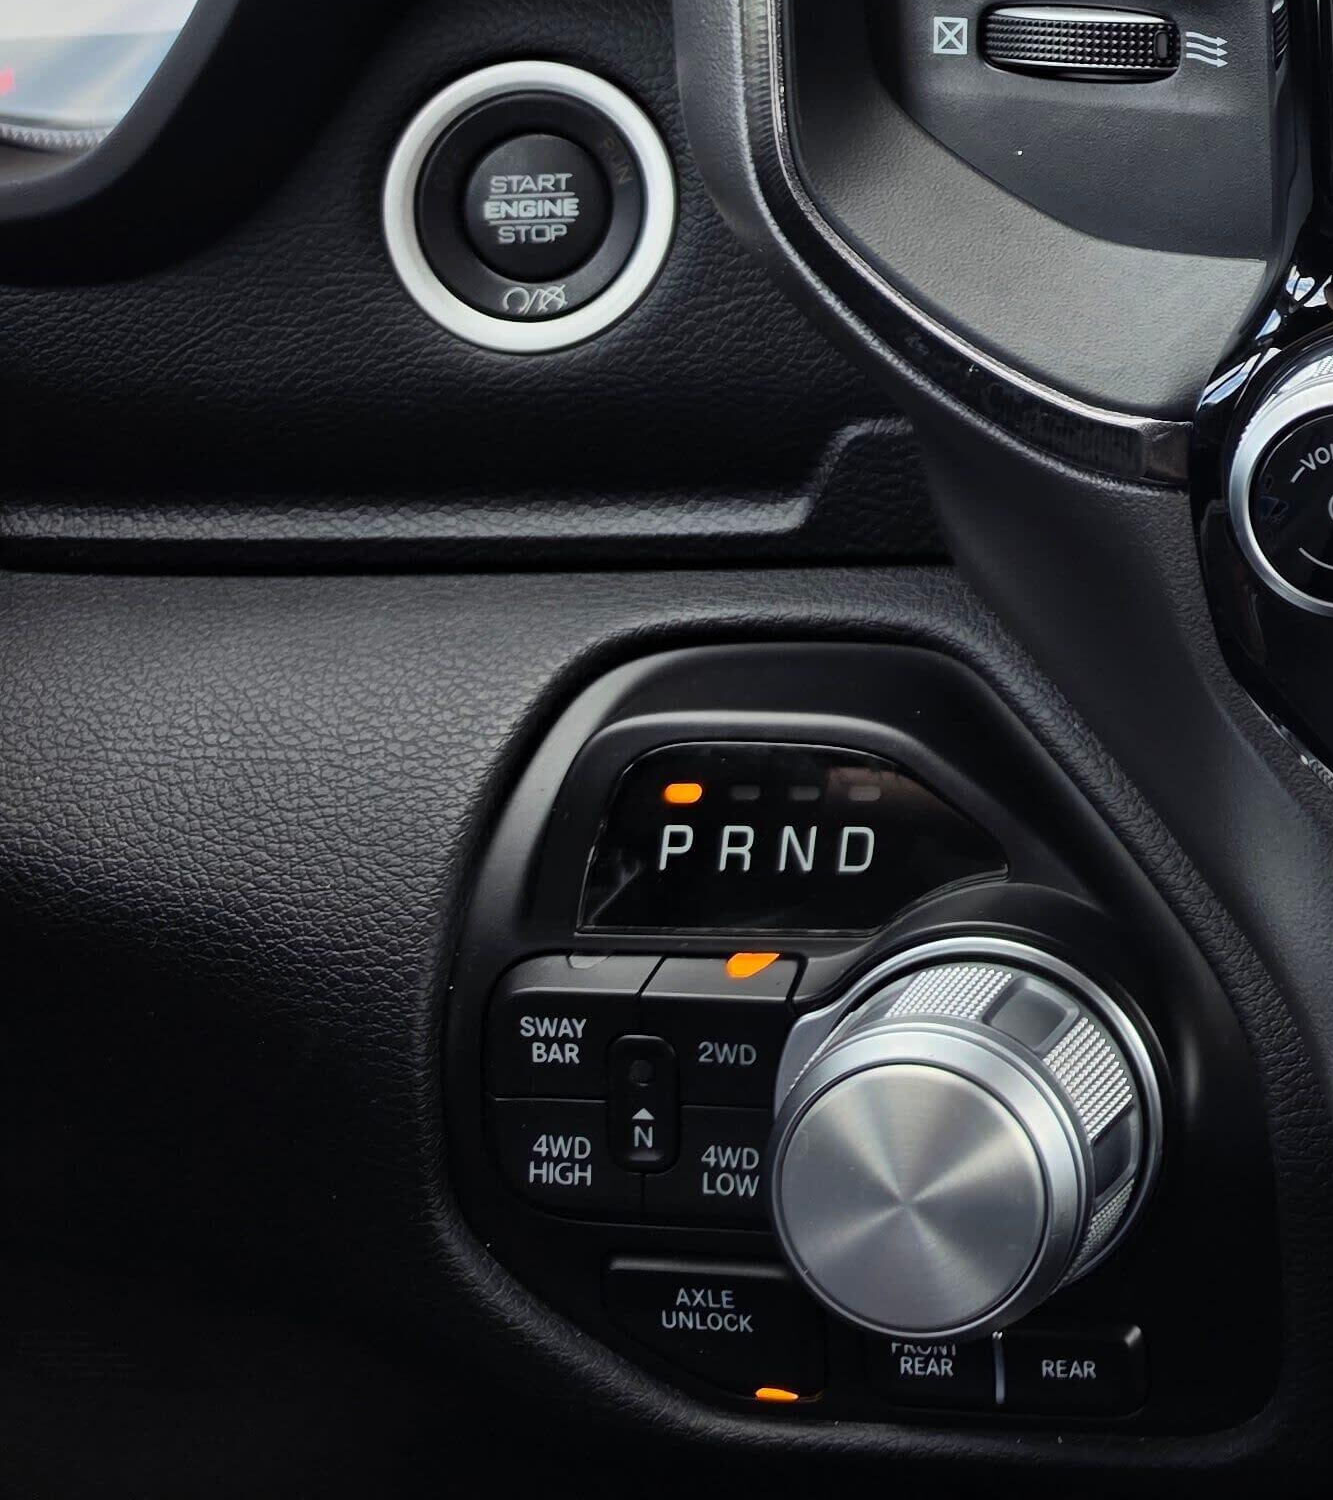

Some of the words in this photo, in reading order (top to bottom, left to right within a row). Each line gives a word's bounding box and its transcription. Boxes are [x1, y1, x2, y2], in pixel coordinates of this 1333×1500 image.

[489, 172, 573, 194] START
[483, 197, 579, 221] ENGINE
[497, 224, 567, 245] STOP
[519, 1016, 587, 1040] SWAY
[531, 1042, 580, 1065] BAR
[698, 1041, 758, 1066] 2WD
[532, 1134, 592, 1161] 4WD
[633, 1125, 654, 1149] N
[700, 1145, 760, 1171] 4WD
[528, 1161, 593, 1187] HIGH
[702, 1172, 760, 1198] LOW
[675, 1287, 735, 1310] AXLE
[660, 1310, 754, 1334] UNLOCK
[899, 1355, 954, 1378] REAR
[1041, 1358, 1097, 1380] REAR
